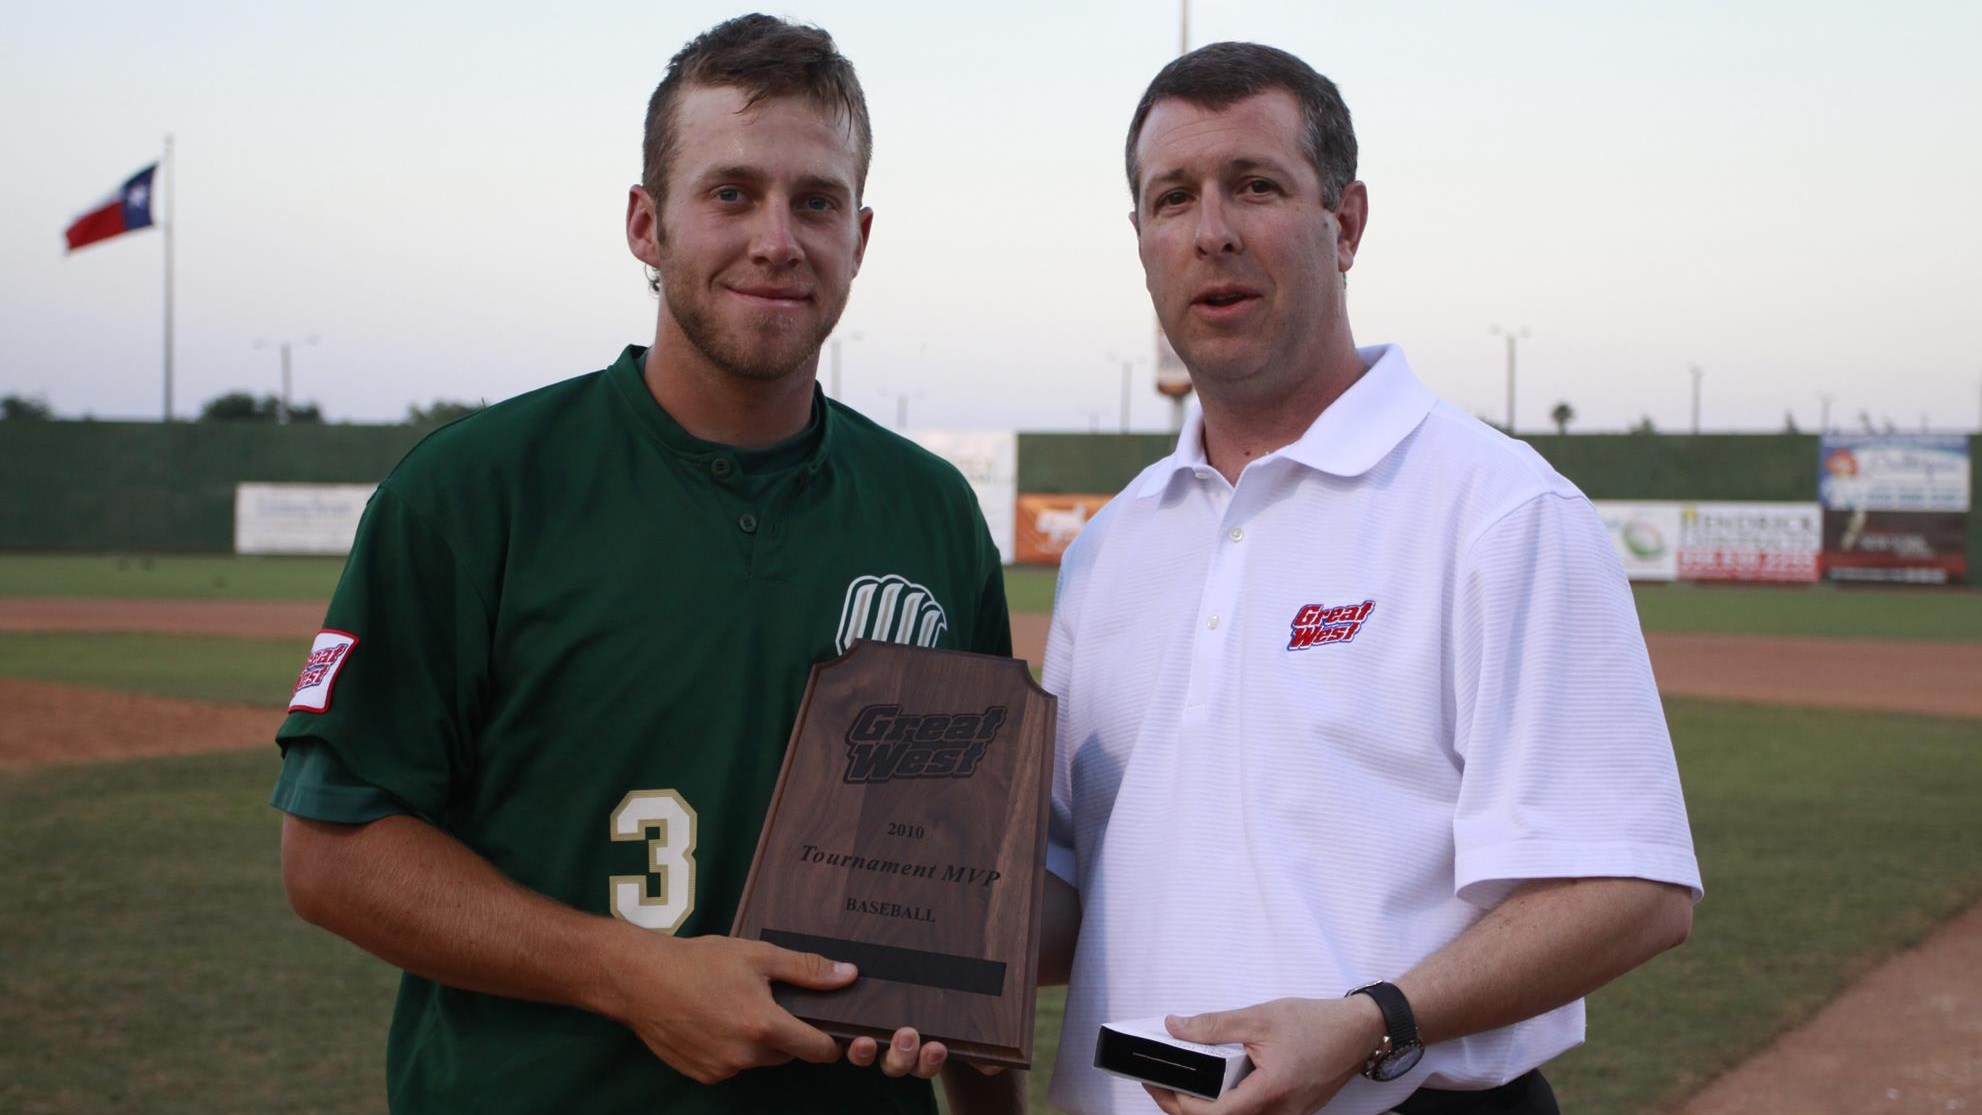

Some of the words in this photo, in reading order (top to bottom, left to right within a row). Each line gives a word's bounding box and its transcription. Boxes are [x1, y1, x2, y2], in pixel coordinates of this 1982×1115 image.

[1291, 600, 1375, 628] Great
[1287, 622, 1361, 651] West
[844, 703, 1007, 745] Great
[843, 741, 988, 784] West
[887, 822, 925, 839] 2010
[609, 788, 697, 936] 3
[800, 844, 937, 878] Tournament
[941, 864, 1001, 887] MVP
[846, 898, 937, 923] BASEBALL
